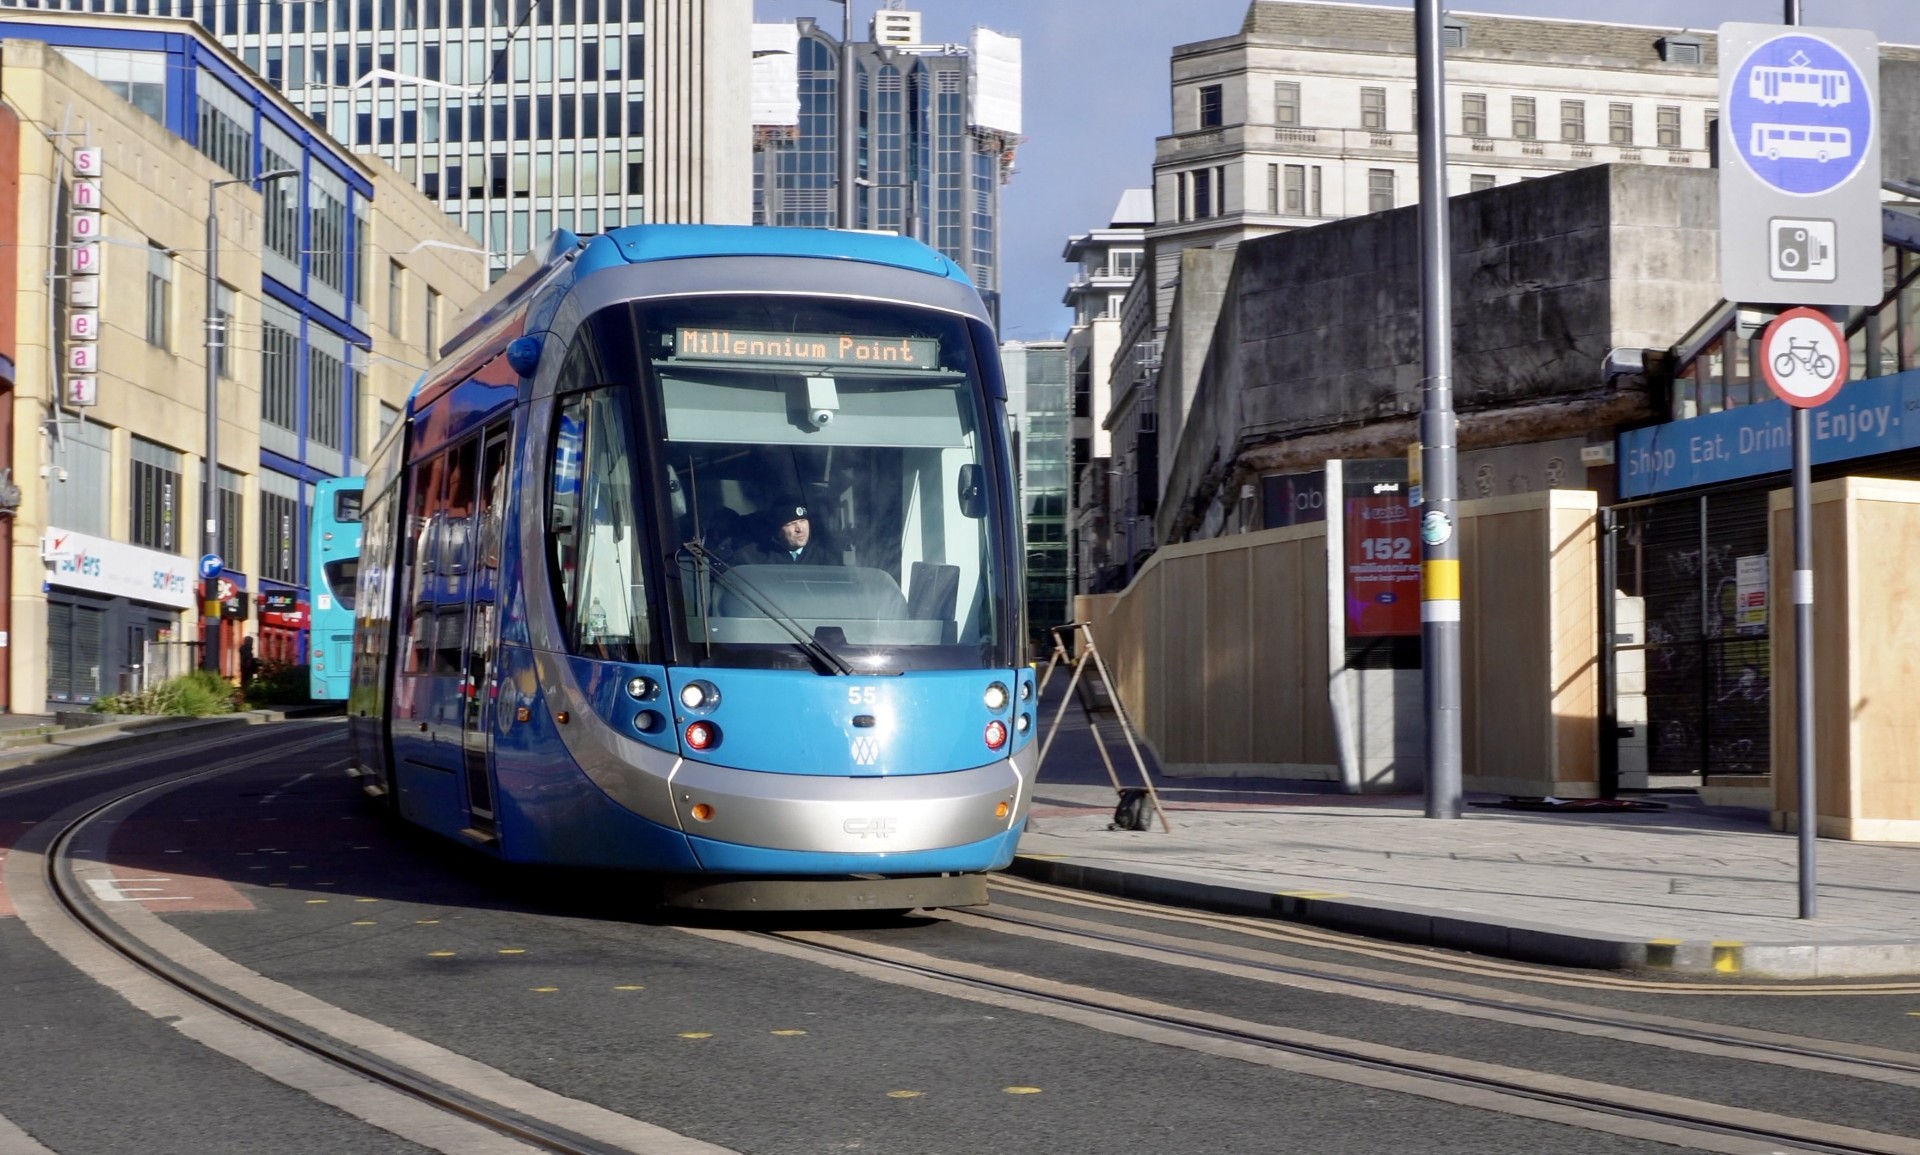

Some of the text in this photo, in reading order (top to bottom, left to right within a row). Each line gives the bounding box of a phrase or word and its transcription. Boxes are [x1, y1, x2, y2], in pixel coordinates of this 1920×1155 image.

[683, 330, 914, 362] Millennium Point
[1629, 446, 1676, 477] Shop
[1690, 433, 1731, 464] Eat,
[1815, 403, 1900, 443] Enjoy.
[1295, 488, 1326, 511] ab
[1361, 537, 1412, 560] 152
[848, 686, 876, 705] 55
[843, 817, 897, 839] CAF
